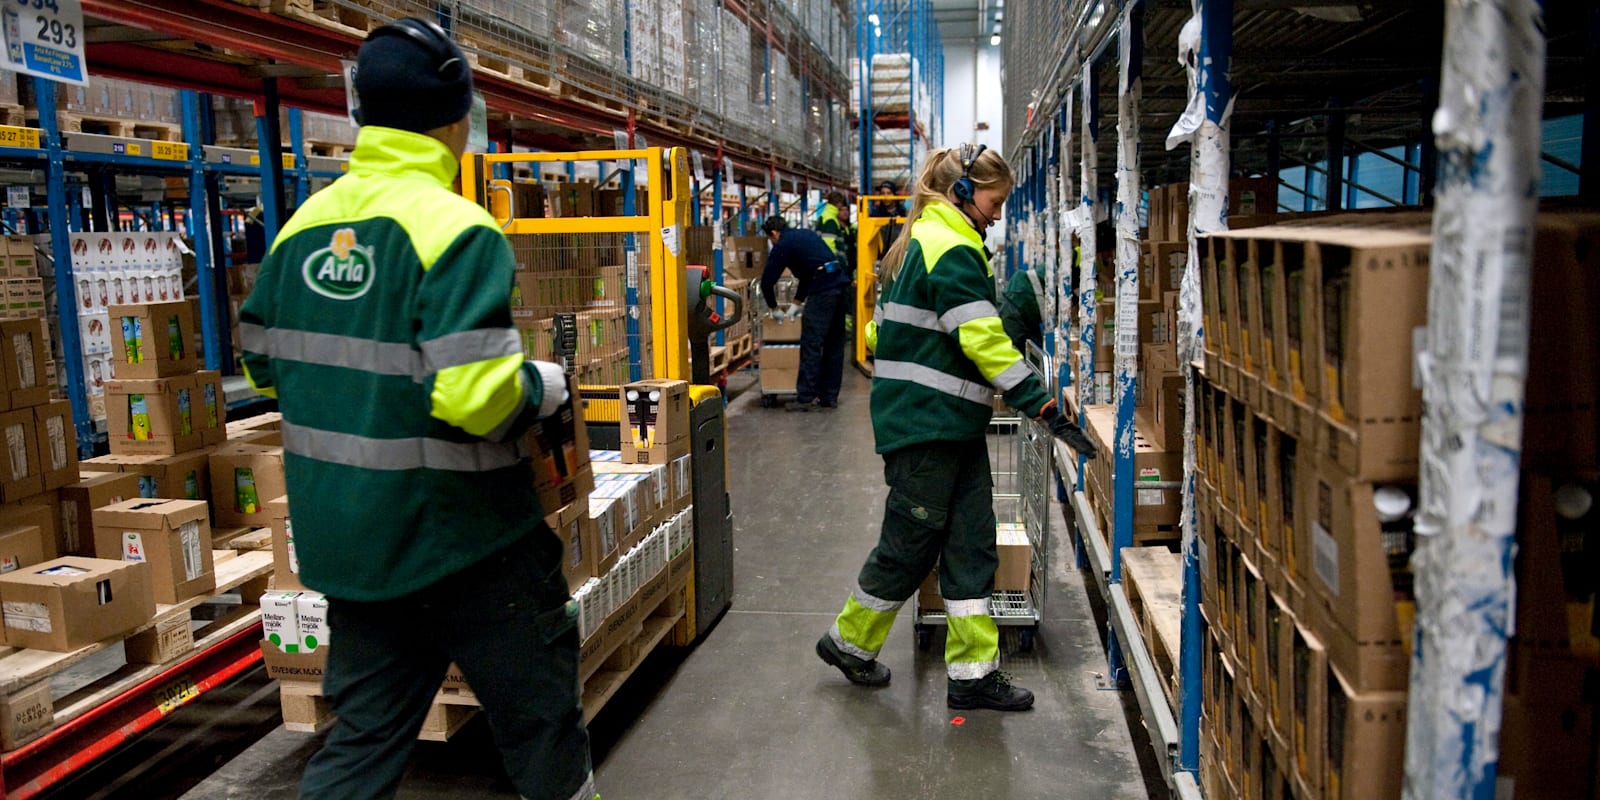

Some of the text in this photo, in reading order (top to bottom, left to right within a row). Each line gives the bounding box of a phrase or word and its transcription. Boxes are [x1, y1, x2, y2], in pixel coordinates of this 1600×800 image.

[36, 15, 76, 48] 293
[8, 132, 16, 141] 27
[317, 255, 365, 282] Arla
[271, 666, 302, 674] SVENSK
[160, 679, 191, 706] 3027
